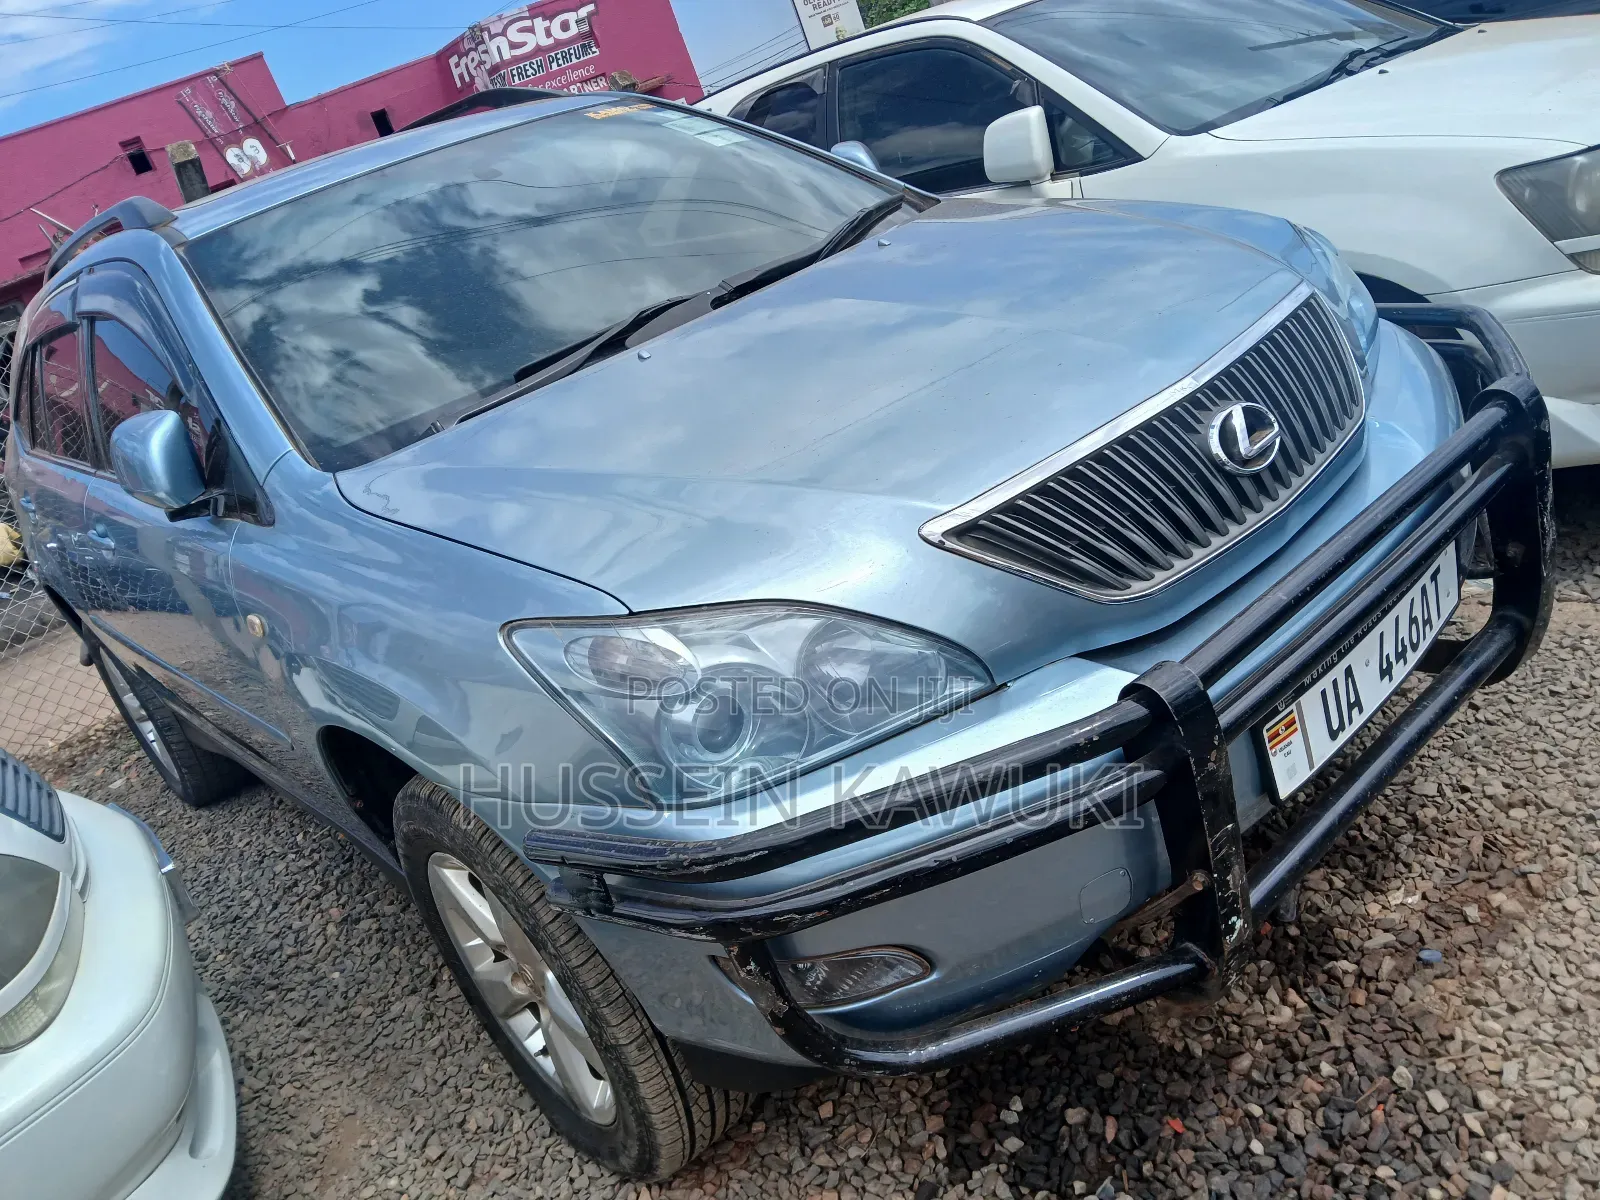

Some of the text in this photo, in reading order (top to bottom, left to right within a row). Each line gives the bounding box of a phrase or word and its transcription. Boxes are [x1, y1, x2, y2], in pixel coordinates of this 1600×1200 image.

[448, 3, 596, 88] FreshStar
[509, 58, 545, 84] FRESH
[547, 40, 599, 69] PERFUME
[545, 64, 596, 90] excellence
[1303, 650, 1338, 687] Making
[1320, 563, 1442, 742] UA 446AT
[1278, 739, 1293, 753] UGANDA
